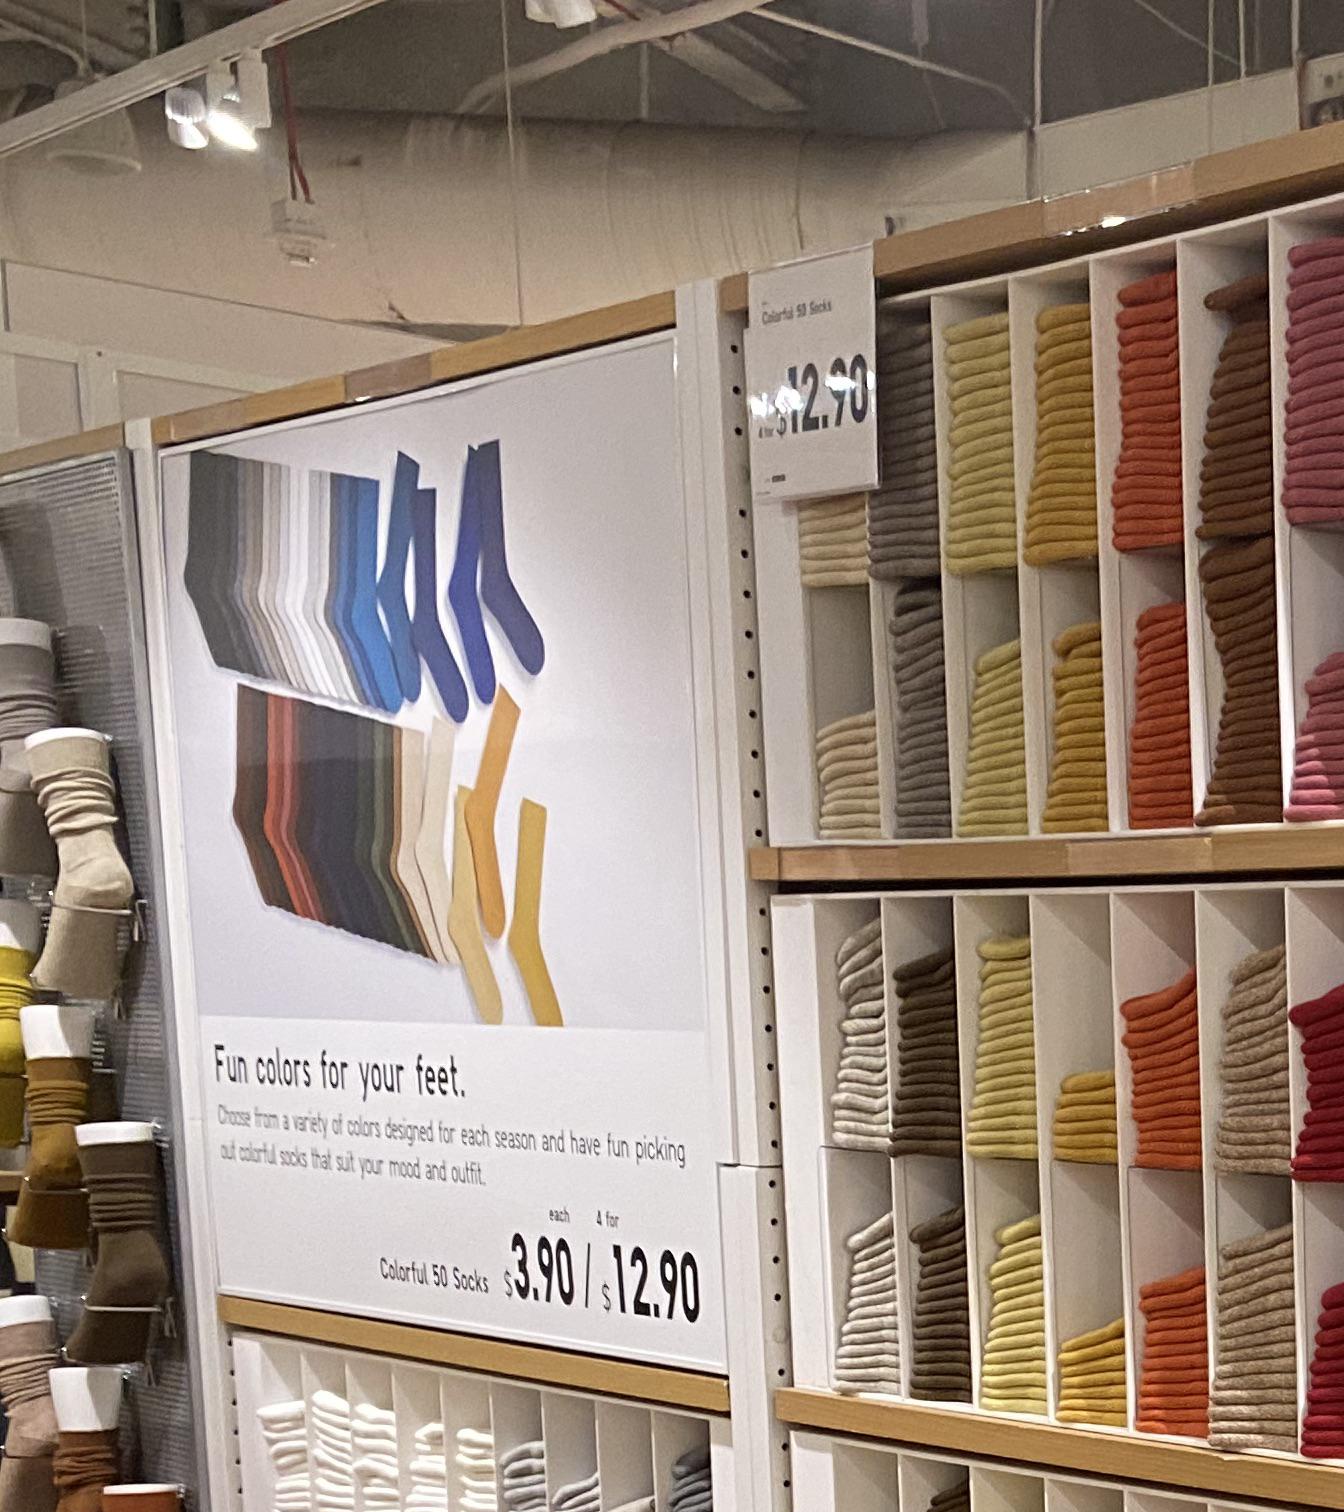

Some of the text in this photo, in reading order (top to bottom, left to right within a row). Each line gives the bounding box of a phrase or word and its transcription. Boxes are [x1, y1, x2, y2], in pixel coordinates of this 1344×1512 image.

[214, 1044, 465, 1102] Fun colors for your feet.
[218, 1104, 685, 1169] Choose from a variety of colors designed for each season and have fun picking
[220, 1142, 487, 1186] out colorful socks that suit your mood and outfit.
[549, 1208, 619, 1229] each 4 for
[380, 1257, 428, 1286] Colorful
[432, 1263, 448, 1287] 50
[453, 1266, 489, 1294] Socks
[504, 1232, 575, 1305] $3.90
[601, 1244, 700, 1323] $12.90
